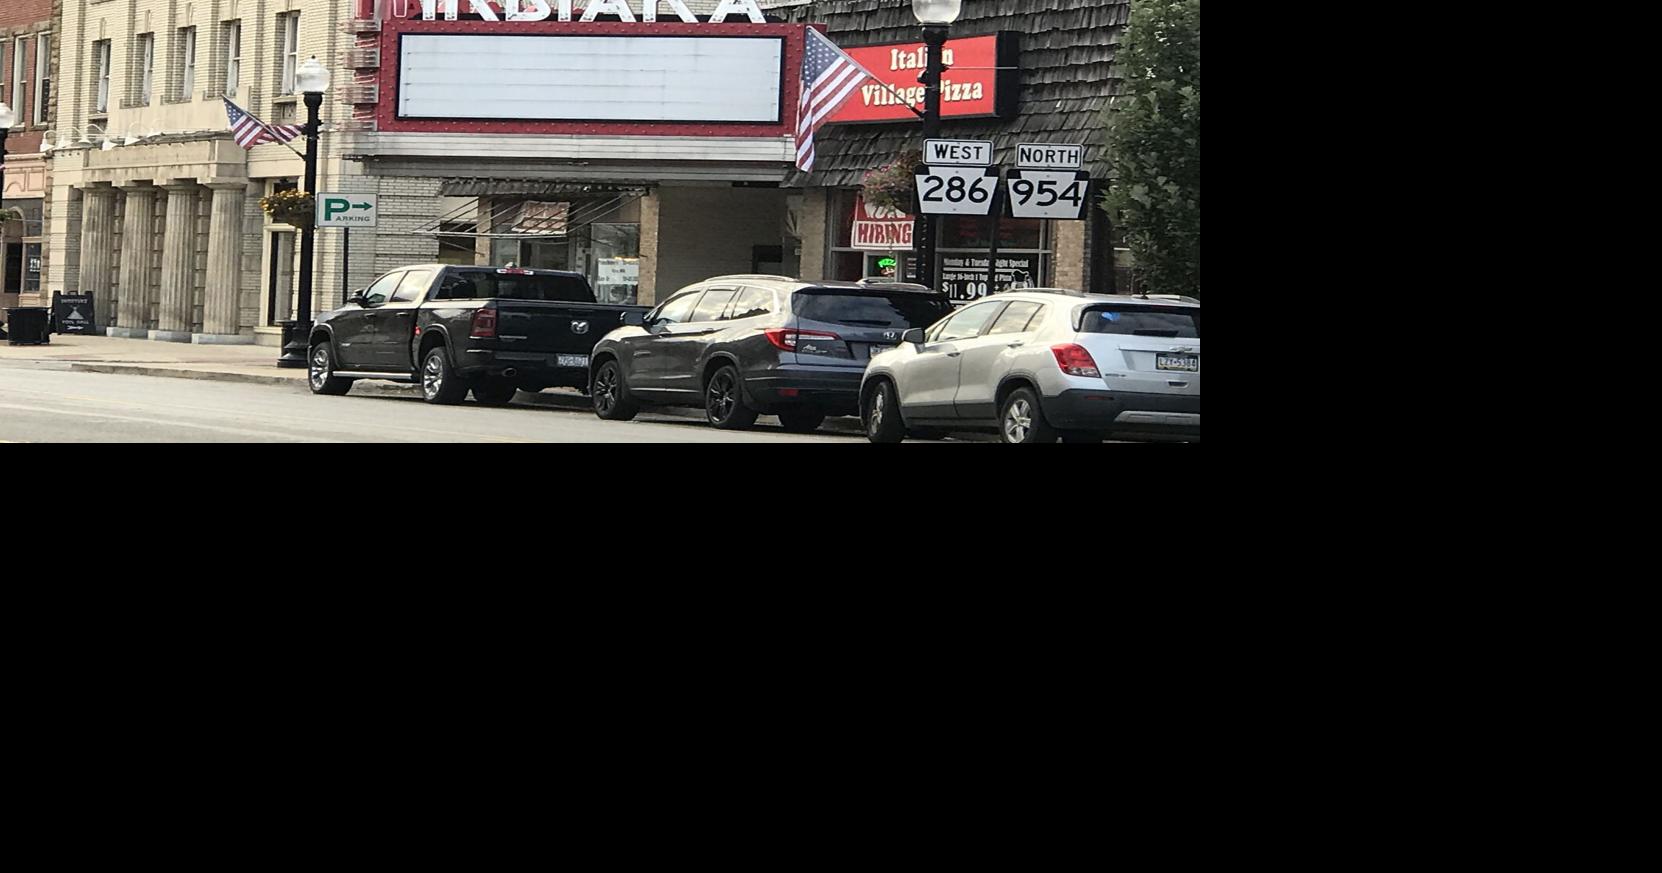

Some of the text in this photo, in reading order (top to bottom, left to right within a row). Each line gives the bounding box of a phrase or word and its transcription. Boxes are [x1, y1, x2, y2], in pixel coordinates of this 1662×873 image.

[890, 46, 954, 71] Italin
[861, 83, 926, 109] Village
[934, 143, 984, 160] WEST
[1019, 148, 1079, 164] NORTH
[923, 175, 989, 203] 286
[1012, 179, 1082, 207] 954
[857, 223, 913, 244] HIRING
[971, 258, 990, 267] Tuesda
